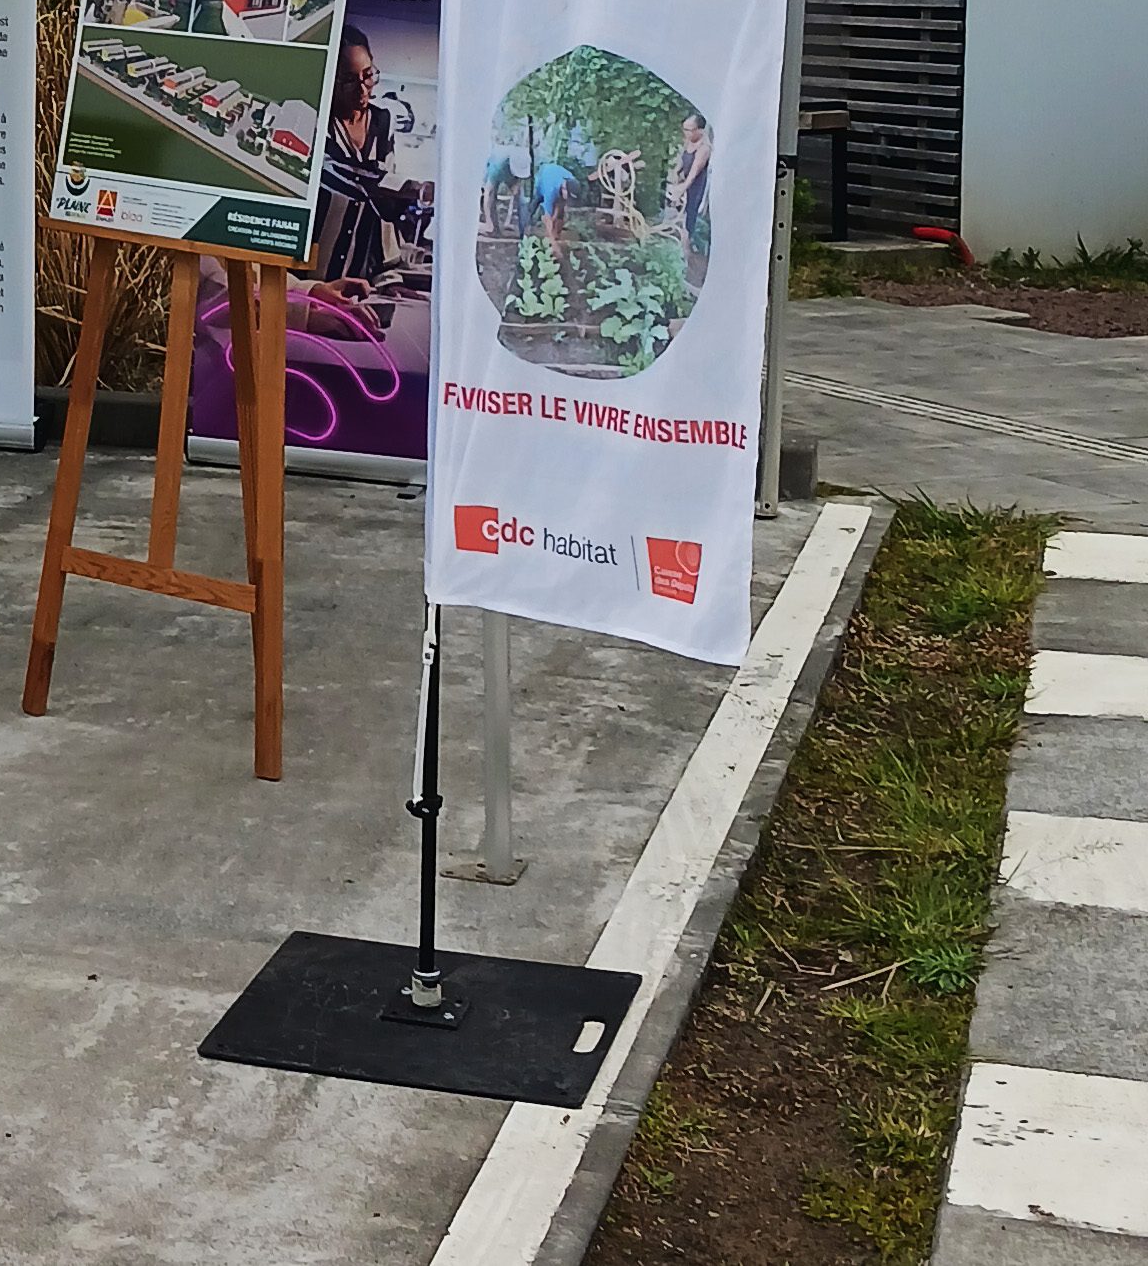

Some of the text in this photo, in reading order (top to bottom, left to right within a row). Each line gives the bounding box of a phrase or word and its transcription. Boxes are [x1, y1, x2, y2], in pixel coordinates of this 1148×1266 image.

[540, 395, 567, 421] LE
[573, 400, 630, 434] VIVRE
[633, 413, 748, 450] ENSEMBLE
[481, 517, 618, 566] cdc habitat
